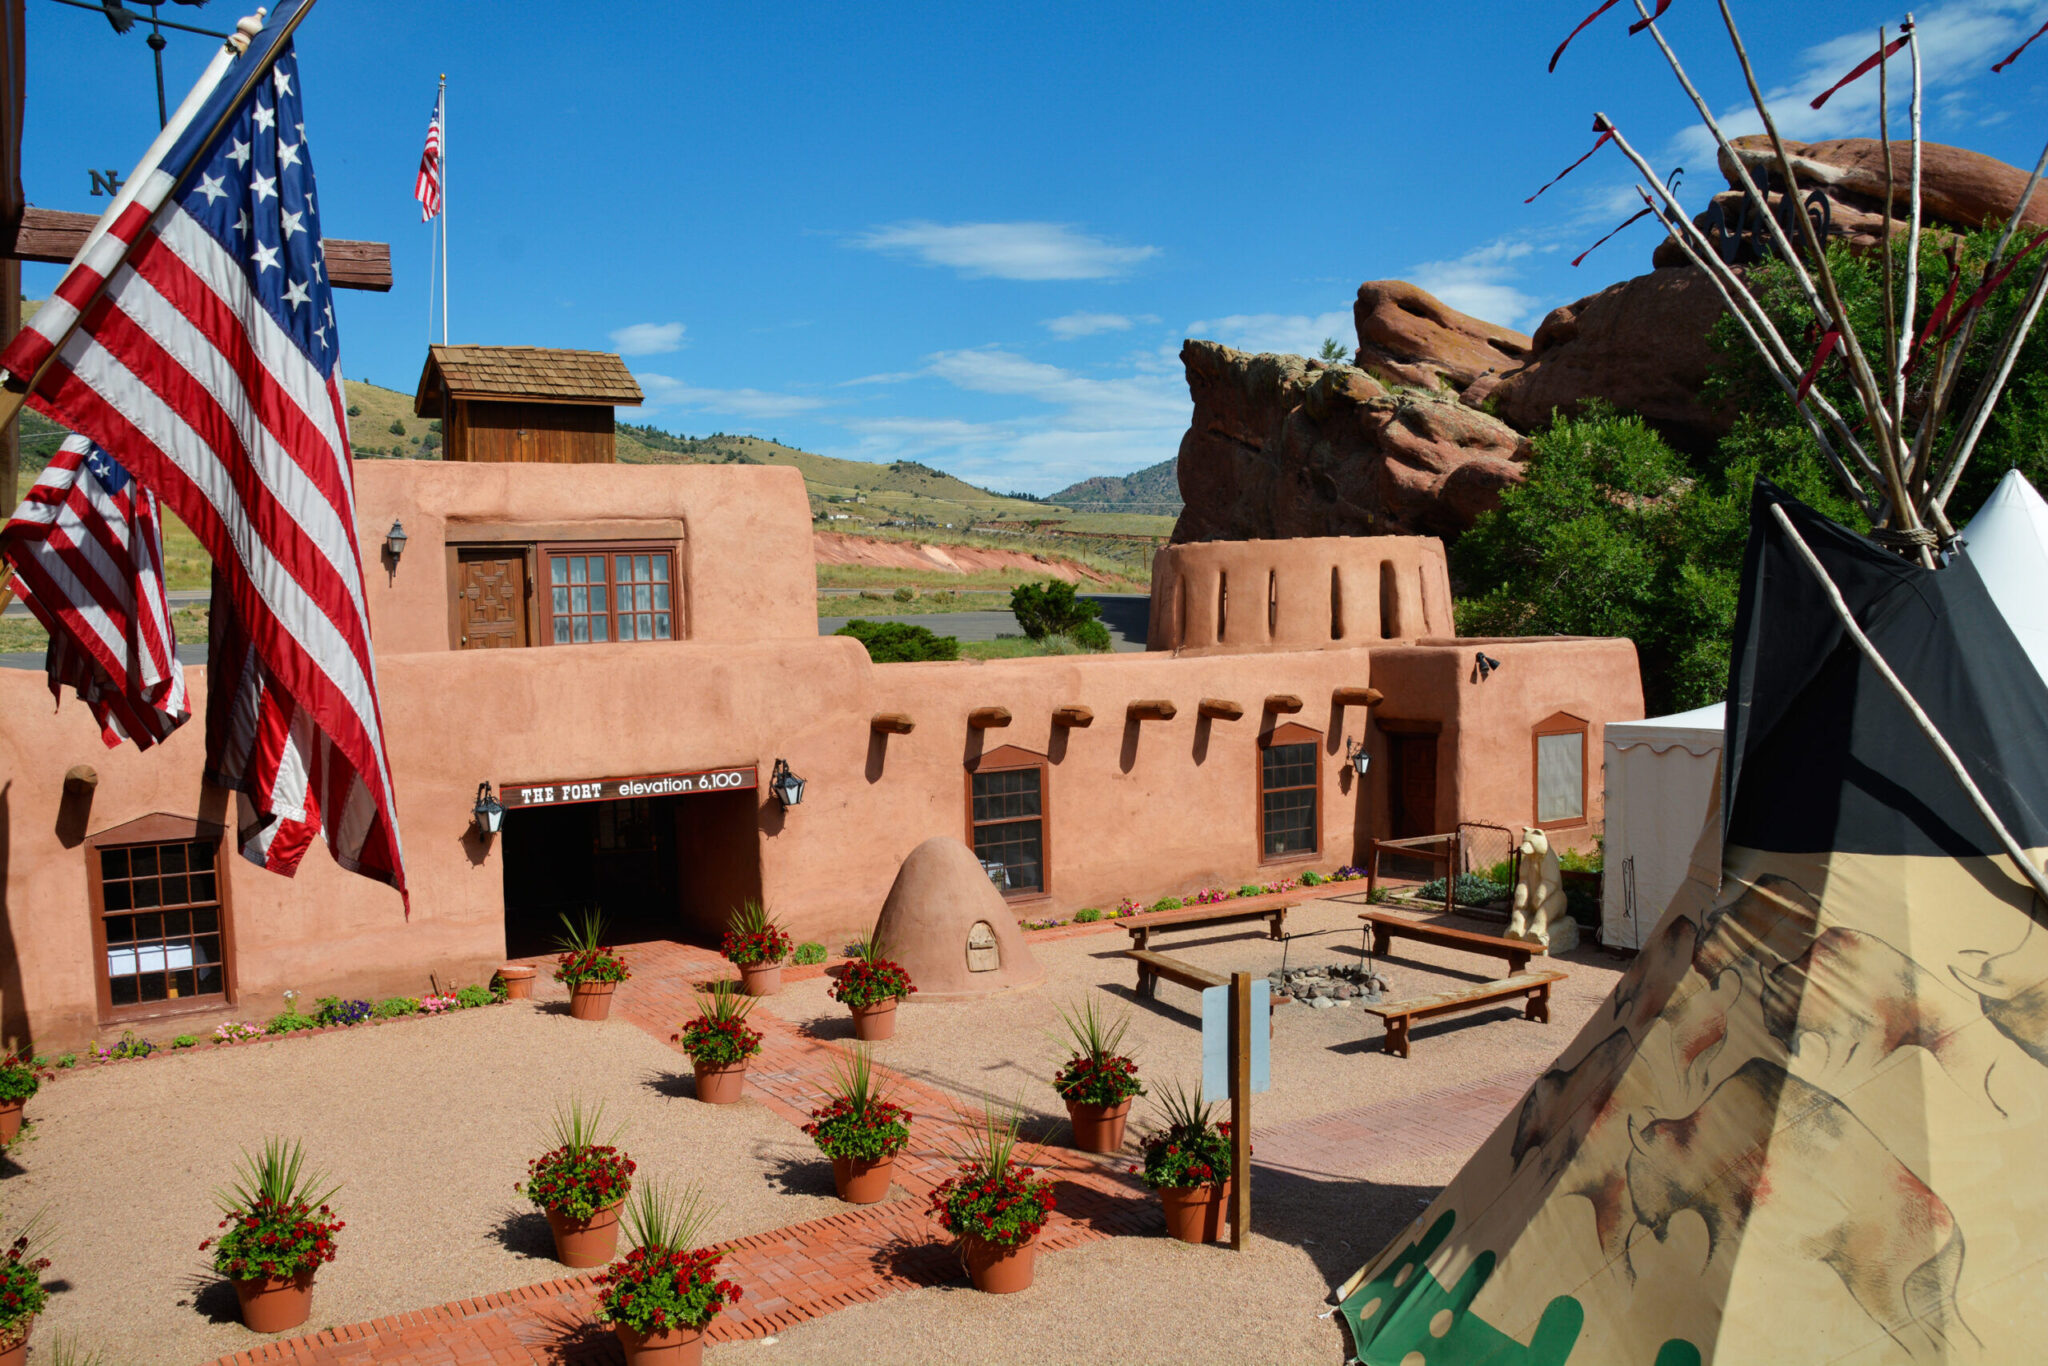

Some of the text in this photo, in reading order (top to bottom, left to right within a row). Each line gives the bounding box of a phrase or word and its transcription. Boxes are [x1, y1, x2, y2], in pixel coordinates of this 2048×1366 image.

[88, 169, 118, 196] N
[521, 772, 742, 804] THE FORT elevation 6,100
